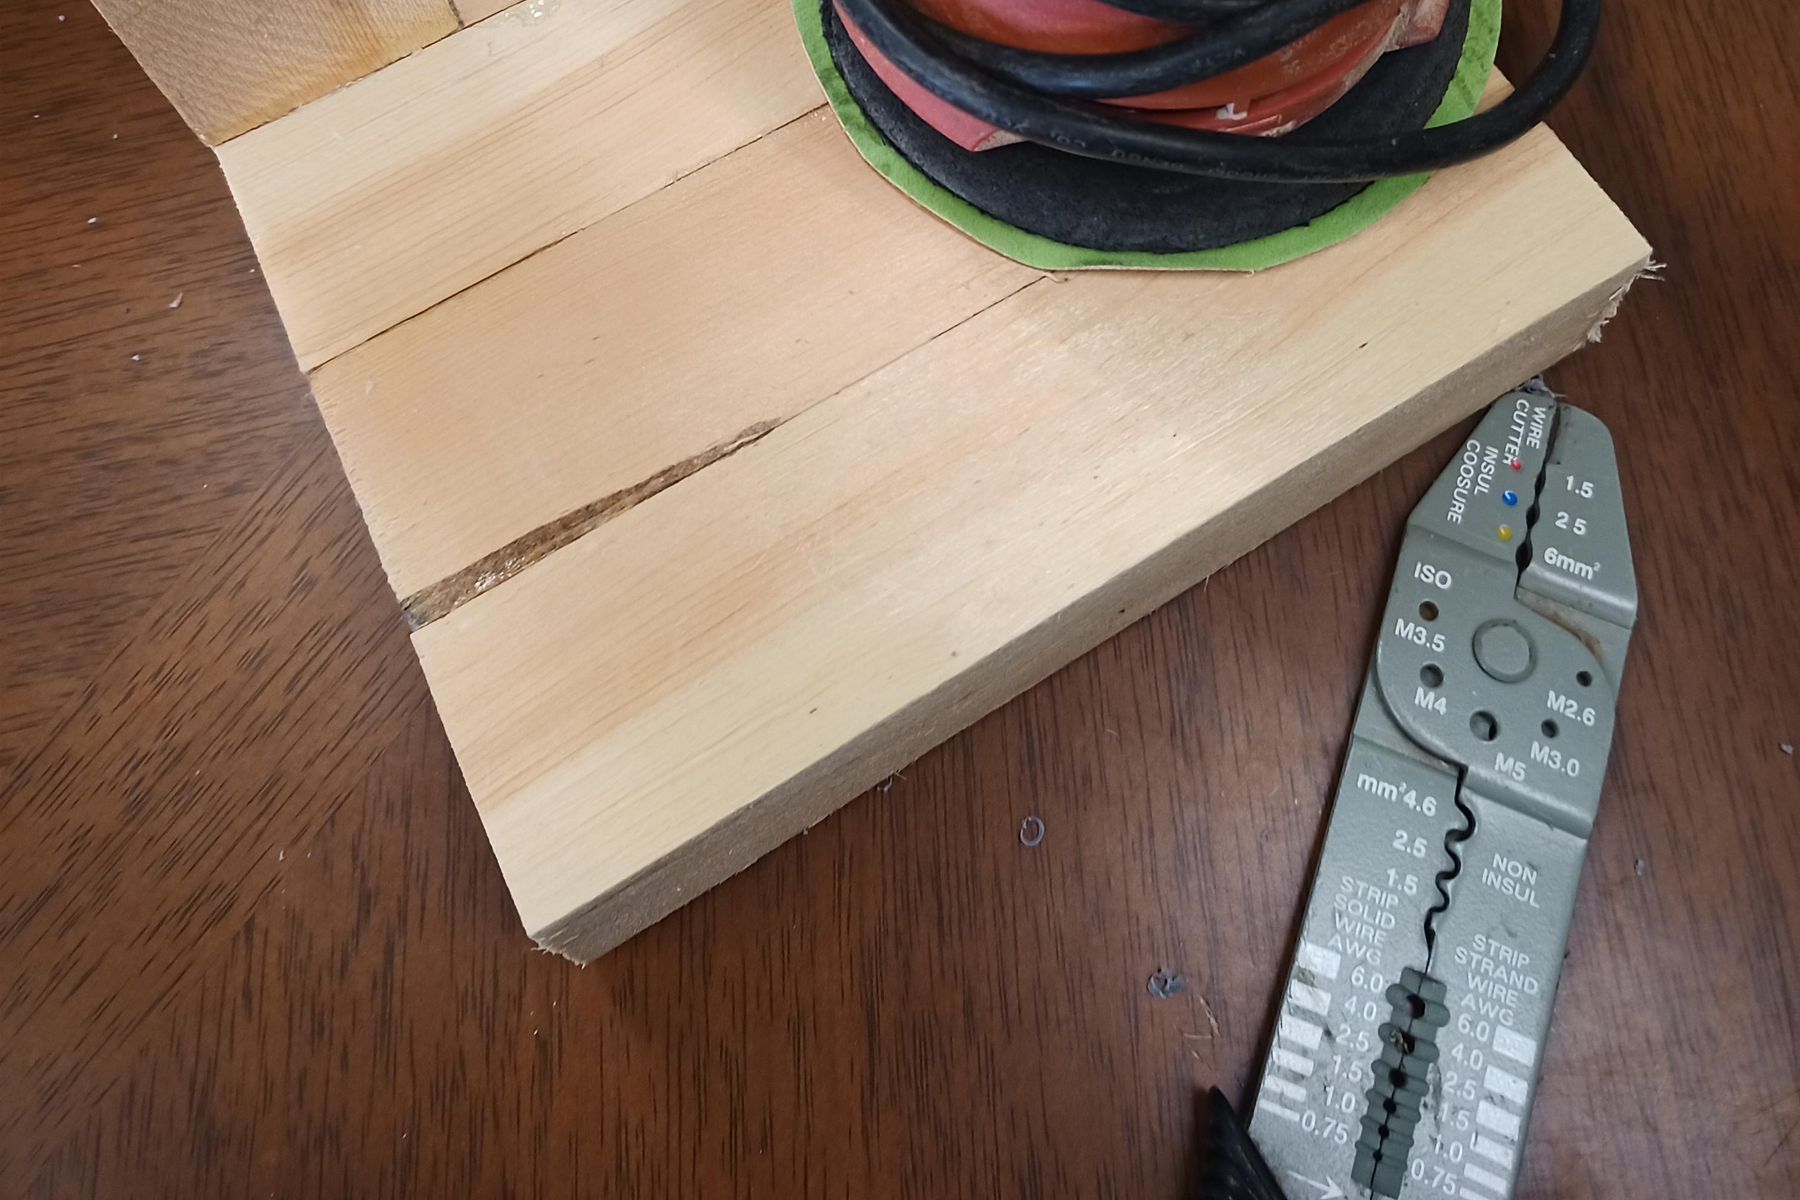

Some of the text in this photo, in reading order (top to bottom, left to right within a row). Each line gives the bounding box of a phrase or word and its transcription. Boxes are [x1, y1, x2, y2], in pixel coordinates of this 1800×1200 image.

[1502, 399, 1529, 466] CUTTER
[1526, 406, 1547, 449] WIRE
[1447, 439, 1481, 524] COOSURE
[1474, 445, 1499, 495] INSUL
[1565, 475, 1594, 498] 1.5
[1414, 561, 1452, 590] ISO
[1394, 618, 1446, 653] M3.5
[1414, 687, 1447, 715] M4
[1546, 690, 1596, 726] M2.6
[1494, 752, 1527, 781] M5
[1530, 741, 1580, 777] M3.0
[1392, 829, 1427, 858] 2.5
[1387, 868, 1419, 896] 1.5
[1492, 853, 1537, 885] NON
[1340, 875, 1399, 909] STRIP
[1482, 868, 1540, 908] INSUL
[1334, 893, 1396, 930] SOLID
[1335, 912, 1387, 948] WIRE
[1327, 933, 1382, 965] AWG
[1472, 934, 1530, 968] STRIP
[1351, 966, 1384, 992] 6.0
[1454, 948, 1539, 995] STRAND
[1467, 972, 1519, 1009] WIRE
[1345, 995, 1377, 1021] 4.0
[1460, 993, 1514, 1027] AWG
[1336, 1025, 1370, 1051] 2.5
[1458, 1014, 1489, 1041] 6.0
[1333, 1054, 1362, 1081] 1.5
[1451, 1043, 1483, 1070] 4.0
[1325, 1086, 1356, 1112] 1.0
[1443, 1070, 1477, 1100] 2.5
[1301, 1110, 1349, 1145] 0.75
[1440, 1102, 1470, 1131] 1.5
[1435, 1134, 1463, 1163] 1.0
[1411, 1158, 1457, 1195] 0.75
